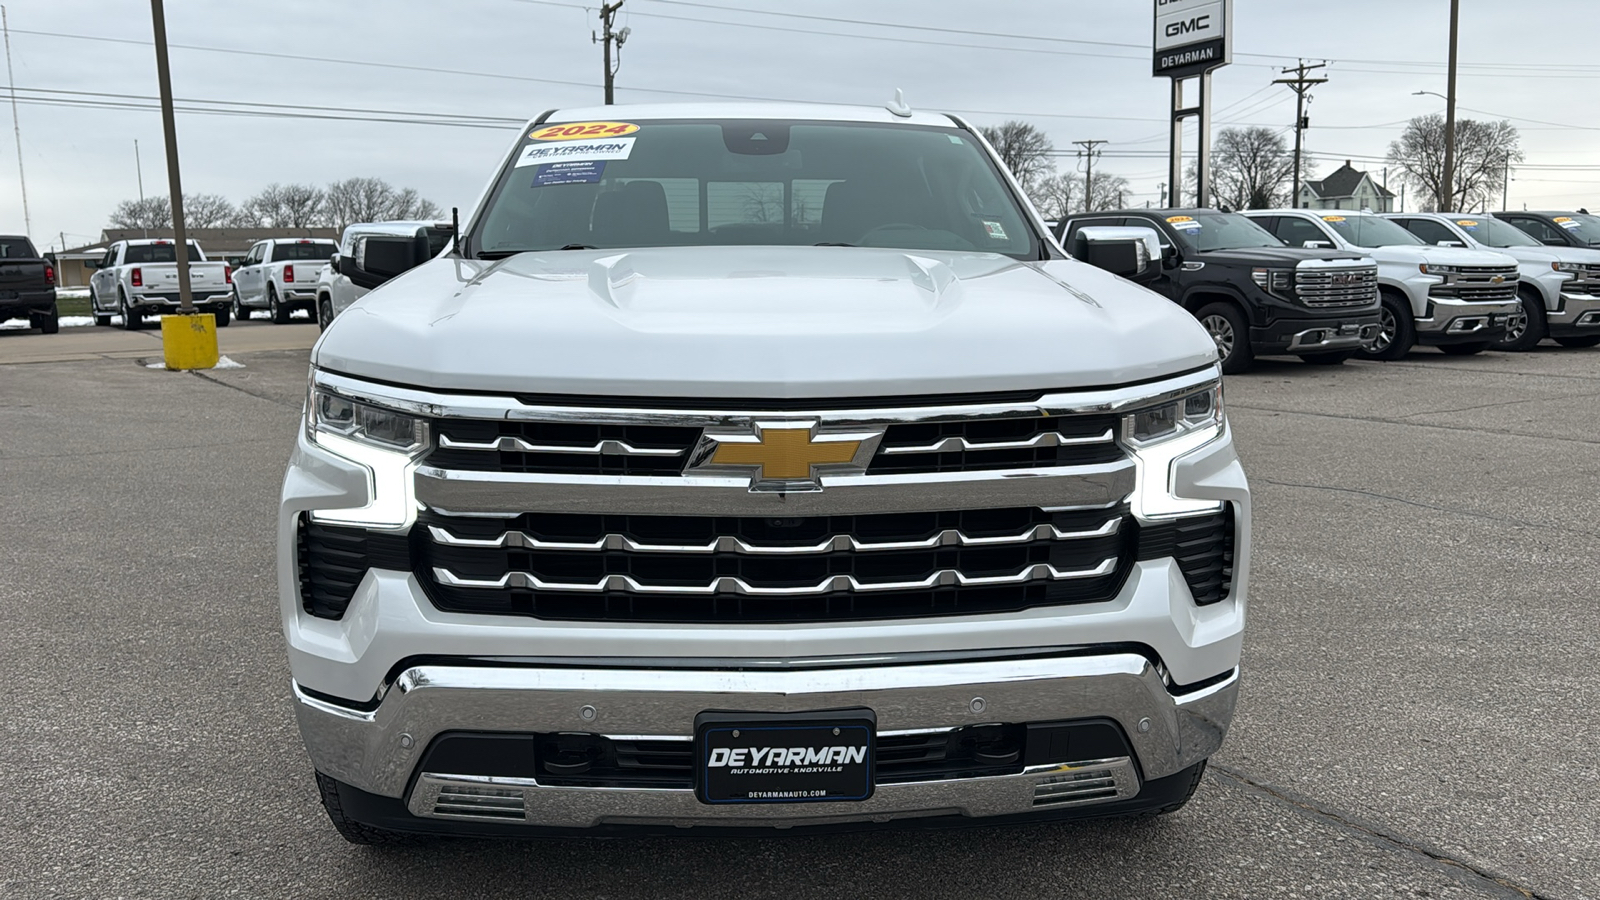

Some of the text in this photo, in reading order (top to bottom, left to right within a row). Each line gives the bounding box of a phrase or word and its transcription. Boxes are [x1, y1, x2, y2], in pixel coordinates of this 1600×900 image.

[1165, 14, 1210, 37] GMC
[1161, 47, 1214, 68] DEYARMAN
[538, 124, 631, 138] 2024
[527, 143, 627, 156] DEYARMAN
[532, 150, 573, 159] CERTIFIED
[707, 745, 867, 768] DEYARMAN
[748, 790, 826, 798] DEYARMANAUTO.COM
